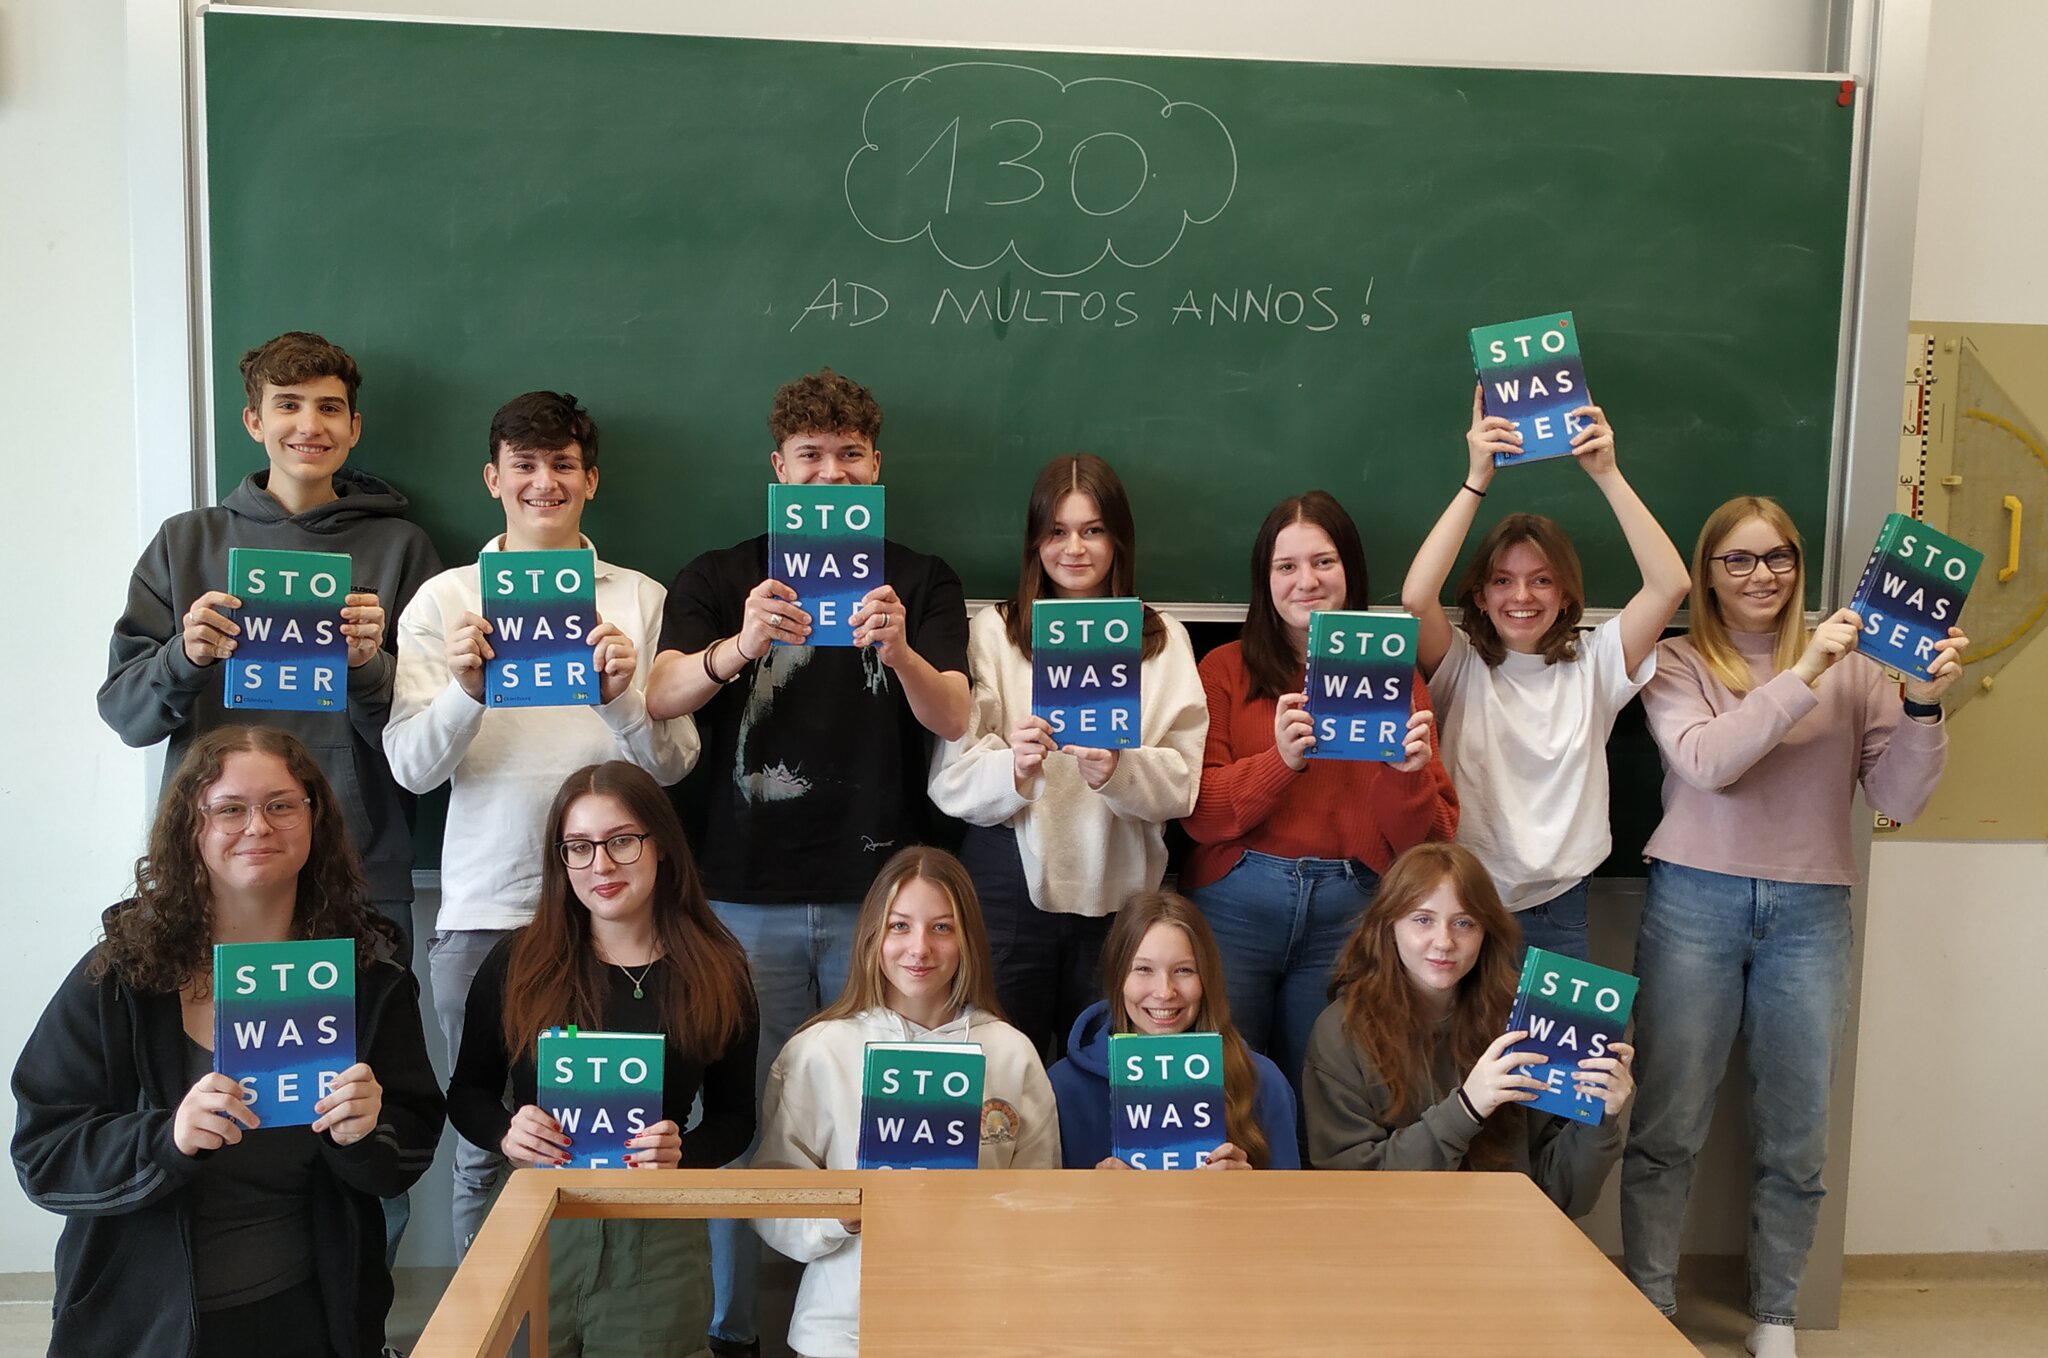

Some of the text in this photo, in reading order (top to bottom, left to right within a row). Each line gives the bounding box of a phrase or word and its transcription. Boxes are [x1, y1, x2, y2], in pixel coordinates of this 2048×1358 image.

[906, 116, 1148, 216] 130
[790, 278, 889, 332] AD
[931, 287, 1140, 327] MULTOS
[1171, 283, 1339, 331] ANNOS
[1489, 330, 1566, 363] STO
[1495, 370, 1574, 404] WAS
[1903, 424, 1916, 435] 2
[1900, 475, 1913, 485] 3
[785, 503, 871, 531] STO
[783, 553, 870, 579] WAS
[1850, 523, 1890, 609] STOWASSE
[1898, 535, 1966, 581] STO
[247, 568, 337, 598] STO
[497, 568, 581, 596] STO
[1882, 572, 1951, 621] WAS
[244, 616, 334, 646] WAS
[497, 614, 583, 641] WAS
[1048, 619, 1129, 645] STO
[1864, 613, 1935, 661] SER
[1328, 631, 1406, 657] STO
[243, 663, 334, 692] SER
[502, 661, 587, 688] SER
[1047, 664, 1128, 689] WAS
[1323, 674, 1401, 701] WAS
[1050, 708, 1129, 733] SER
[1320, 718, 1397, 744] SER
[236, 961, 339, 995] STO
[1539, 971, 1621, 1013] STO
[233, 1015, 338, 1050] WAS
[1529, 1014, 1609, 1058] WAS
[554, 1056, 648, 1084] STO
[1126, 1053, 1210, 1081] STO
[881, 1068, 970, 1098] STO
[552, 1107, 646, 1134] WAS
[1125, 1102, 1211, 1130] WAS
[877, 1117, 965, 1146] WAS
